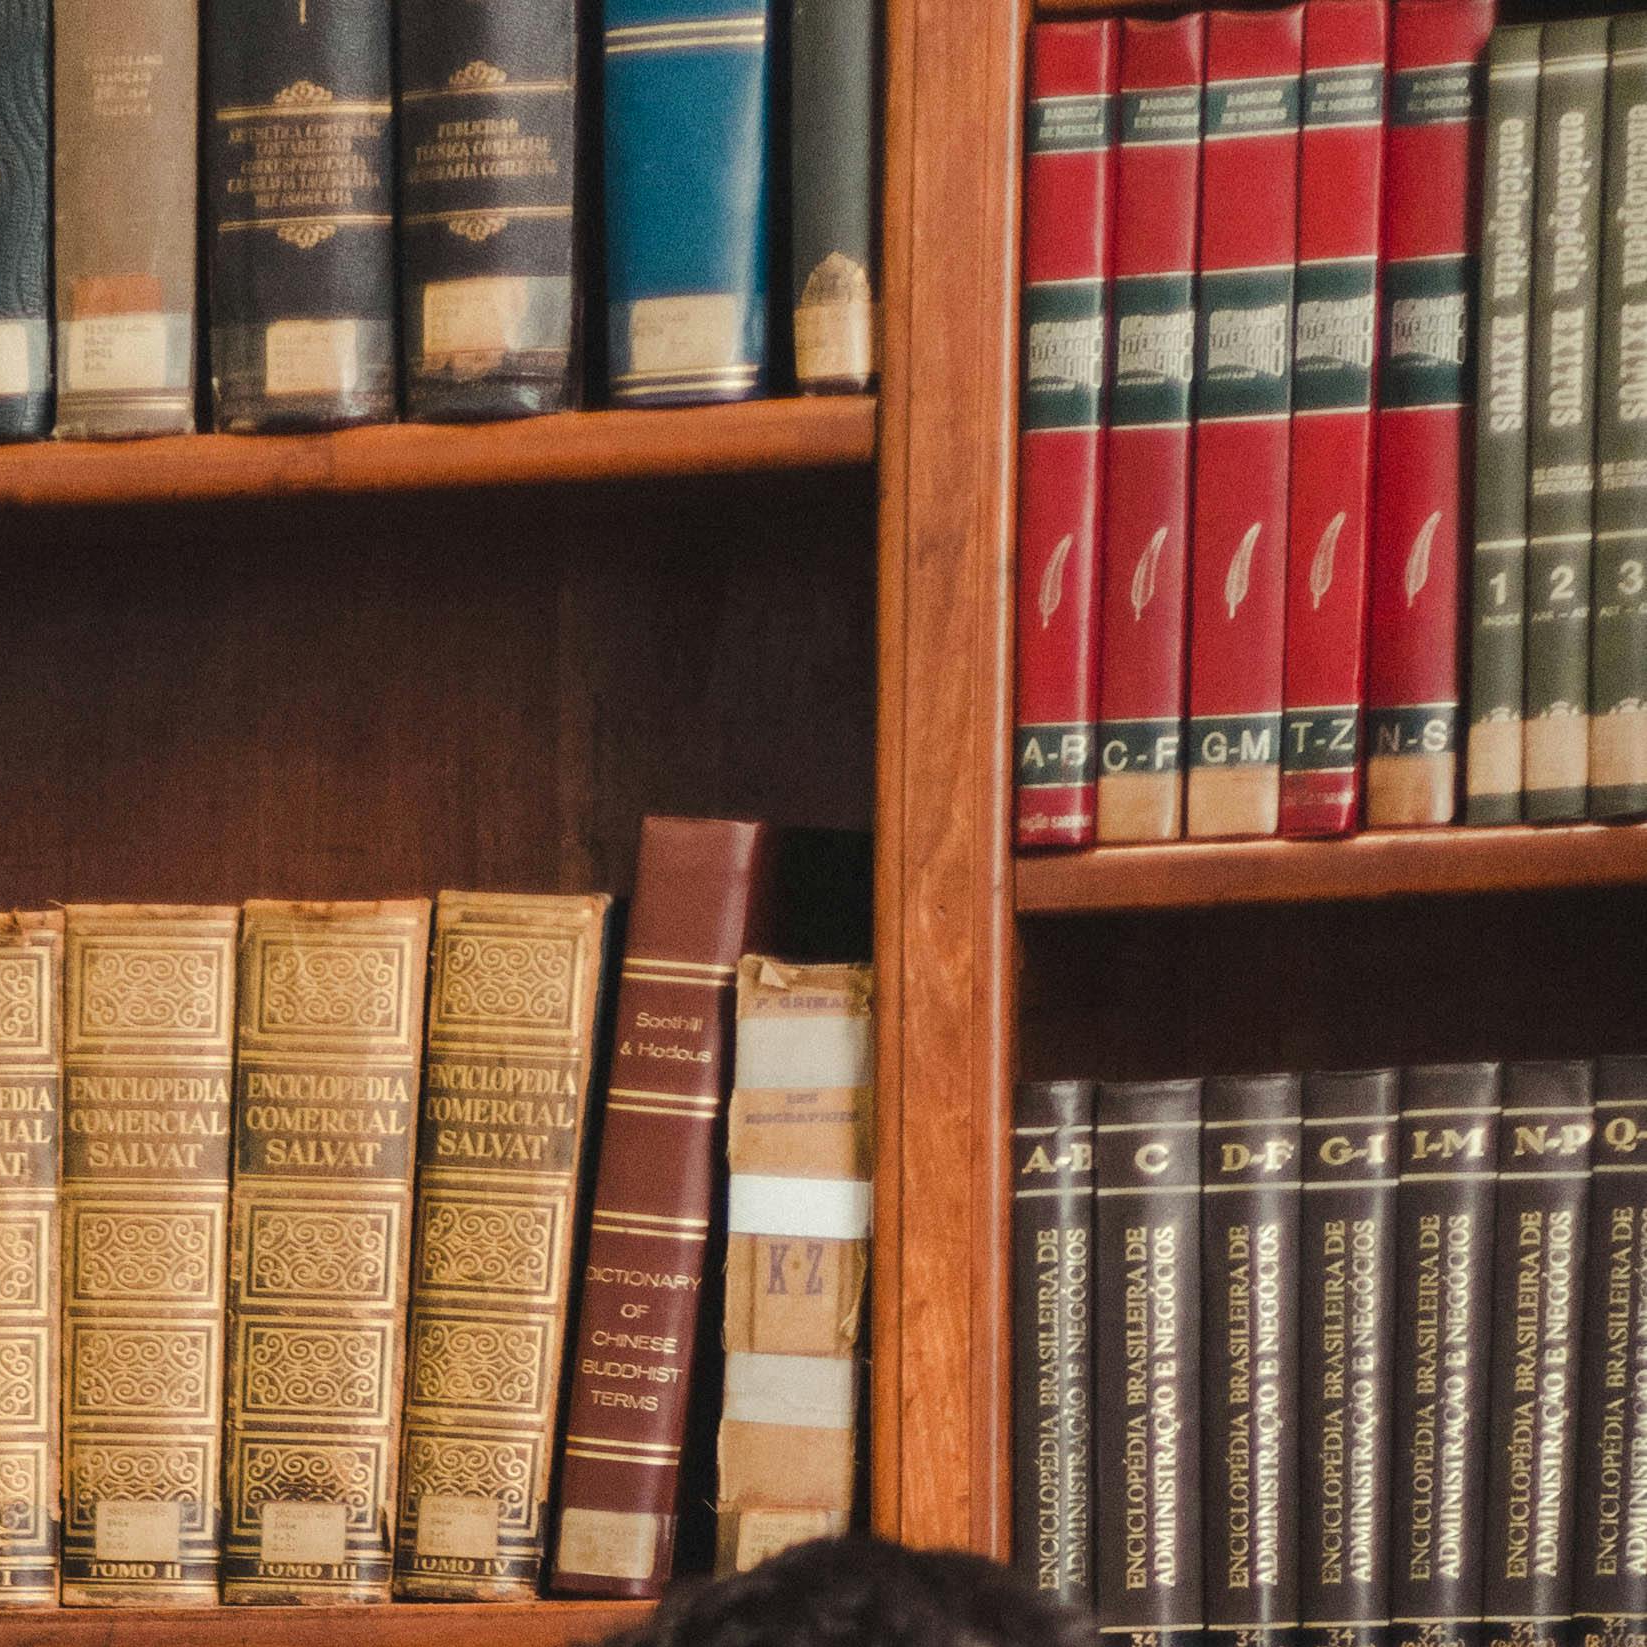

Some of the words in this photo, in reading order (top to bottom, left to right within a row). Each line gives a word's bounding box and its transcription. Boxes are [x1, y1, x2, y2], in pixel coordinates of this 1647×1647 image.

[1489, 572, 1507, 606] 1
[1550, 564, 1575, 600] 2
[1618, 560, 1644, 595] 3
[1201, 729, 1271, 764] G-M
[1290, 719, 1354, 754] T-Z
[635, 1012, 703, 1032] Soothill
[619, 1040, 633, 1056] &
[638, 1042, 713, 1063] Hodous
[70, 1076, 230, 1102] ENCICLOPEDIA
[247, 1073, 410, 1103] ENCICLOPEDIA
[428, 1063, 577, 1096] ENCICLOPEDIA
[69, 1109, 227, 1135] COMERCIAL
[245, 1106, 406, 1136] COMERCIAL
[425, 1097, 574, 1128] COMERCIAL
[89, 1142, 204, 1168] SALVAT
[265, 1139, 382, 1168] SALVAT
[437, 1130, 548, 1161] SALVAT
[1221, 1139, 1295, 1173] D-F
[1319, 1133, 1387, 1166] G-I
[1411, 1125, 1486, 1159] I-M
[1514, 1124, 1593, 1157] N-P
[1134, 1143, 1170, 1175] C
[1125, 1226, 1147, 1262] DE
[1228, 1224, 1250, 1260] DE
[1323, 1219, 1345, 1255] DE
[1420, 1214, 1441, 1249] DE
[585, 1266, 702, 1292] DICTIONARY
[1148, 1225, 1176, 1355] NEGÓCIOS
[1253, 1223, 1279, 1352] NEGÓCIOS
[1348, 1219, 1376, 1347] NEGÓCIOS
[1442, 1214, 1471, 1343] NEGÓCIOS
[619, 1303, 650, 1319] OF
[1416, 1254, 1440, 1395] BRASILEIRA
[591, 1330, 678, 1354] CHINESE
[1126, 1265, 1147, 1406] BRASILEIRA
[1228, 1265, 1250, 1405] BRASILEIRA
[1323, 1260, 1345, 1399] BRASILEIRA
[580, 1359, 683, 1384] BUDDHIST
[1154, 1359, 1177, 1378] E
[1256, 1357, 1279, 1377] E
[1352, 1352, 1374, 1372] E
[1445, 1348, 1467, 1368] E
[591, 1389, 659, 1412] TERMS
[1151, 1385, 1181, 1588] ADMINISTRAÇÃO
[1254, 1383, 1283, 1586] ADMINISTRAÇÃO
[1349, 1378, 1378, 1583] ADMINISTRAÇÃO
[1409, 1403, 1436, 1582] ENCICLOPÉDIA
[1438, 1374, 1470, 1580] ADMINISTRAÇÃO
[1122, 1414, 1147, 1590] ENCICLOPÉDIA
[1225, 1412, 1249, 1589] ENCICLOPÉDIA
[1319, 1408, 1344, 1585] ENCICLOPÉDIA
[2, 1570, 13, 1586] I
[88, 1563, 156, 1578] TOMO
[162, 1564, 182, 1579] II
[257, 1563, 324, 1578] TOMO
[331, 1563, 358, 1580] III
[413, 1558, 476, 1573] TOMO
[483, 1559, 510, 1575] IV
